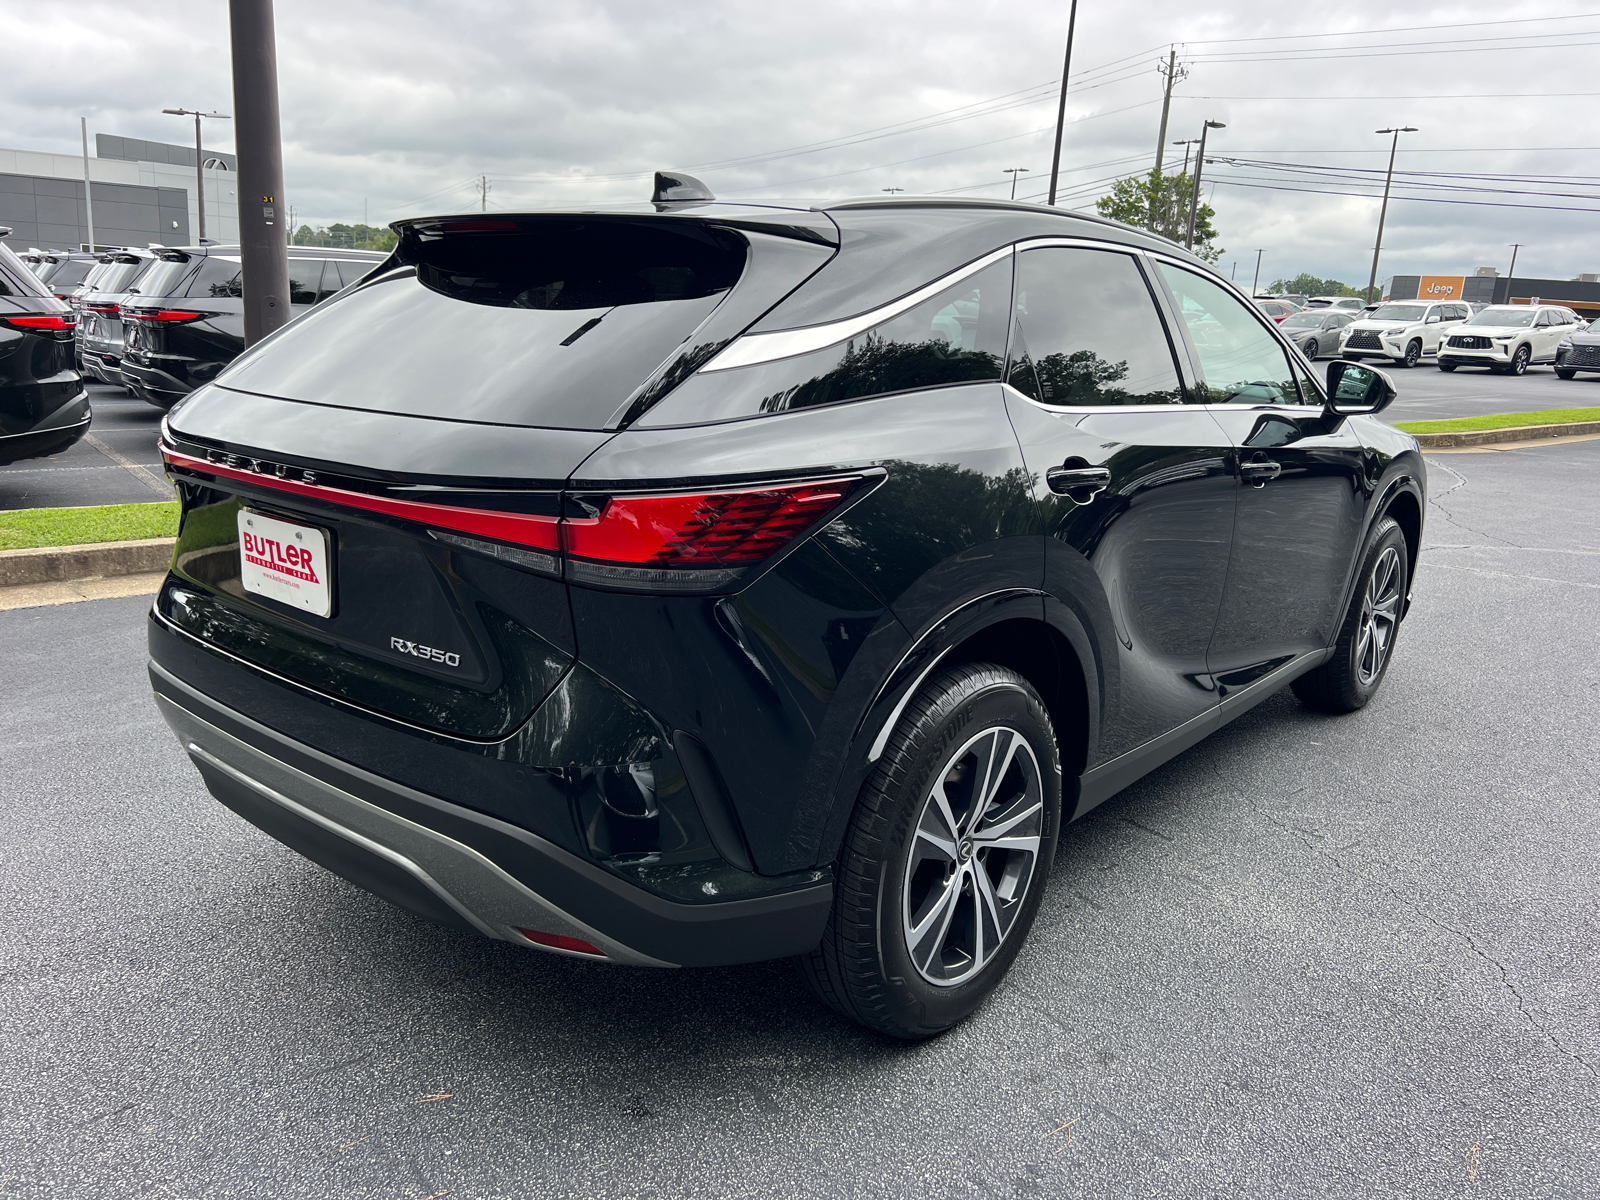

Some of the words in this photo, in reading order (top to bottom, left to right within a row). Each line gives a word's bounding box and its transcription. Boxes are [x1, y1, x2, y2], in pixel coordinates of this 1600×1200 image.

[262, 195, 274, 203] 31
[1427, 282, 1454, 296] Jeep
[206, 449, 317, 483] LEXUS
[245, 554, 287, 574] AUTOMOTIVE
[292, 570, 317, 583] GROUP
[390, 636, 461, 667] RX350
[890, 704, 974, 848] BRIDGESTONE
